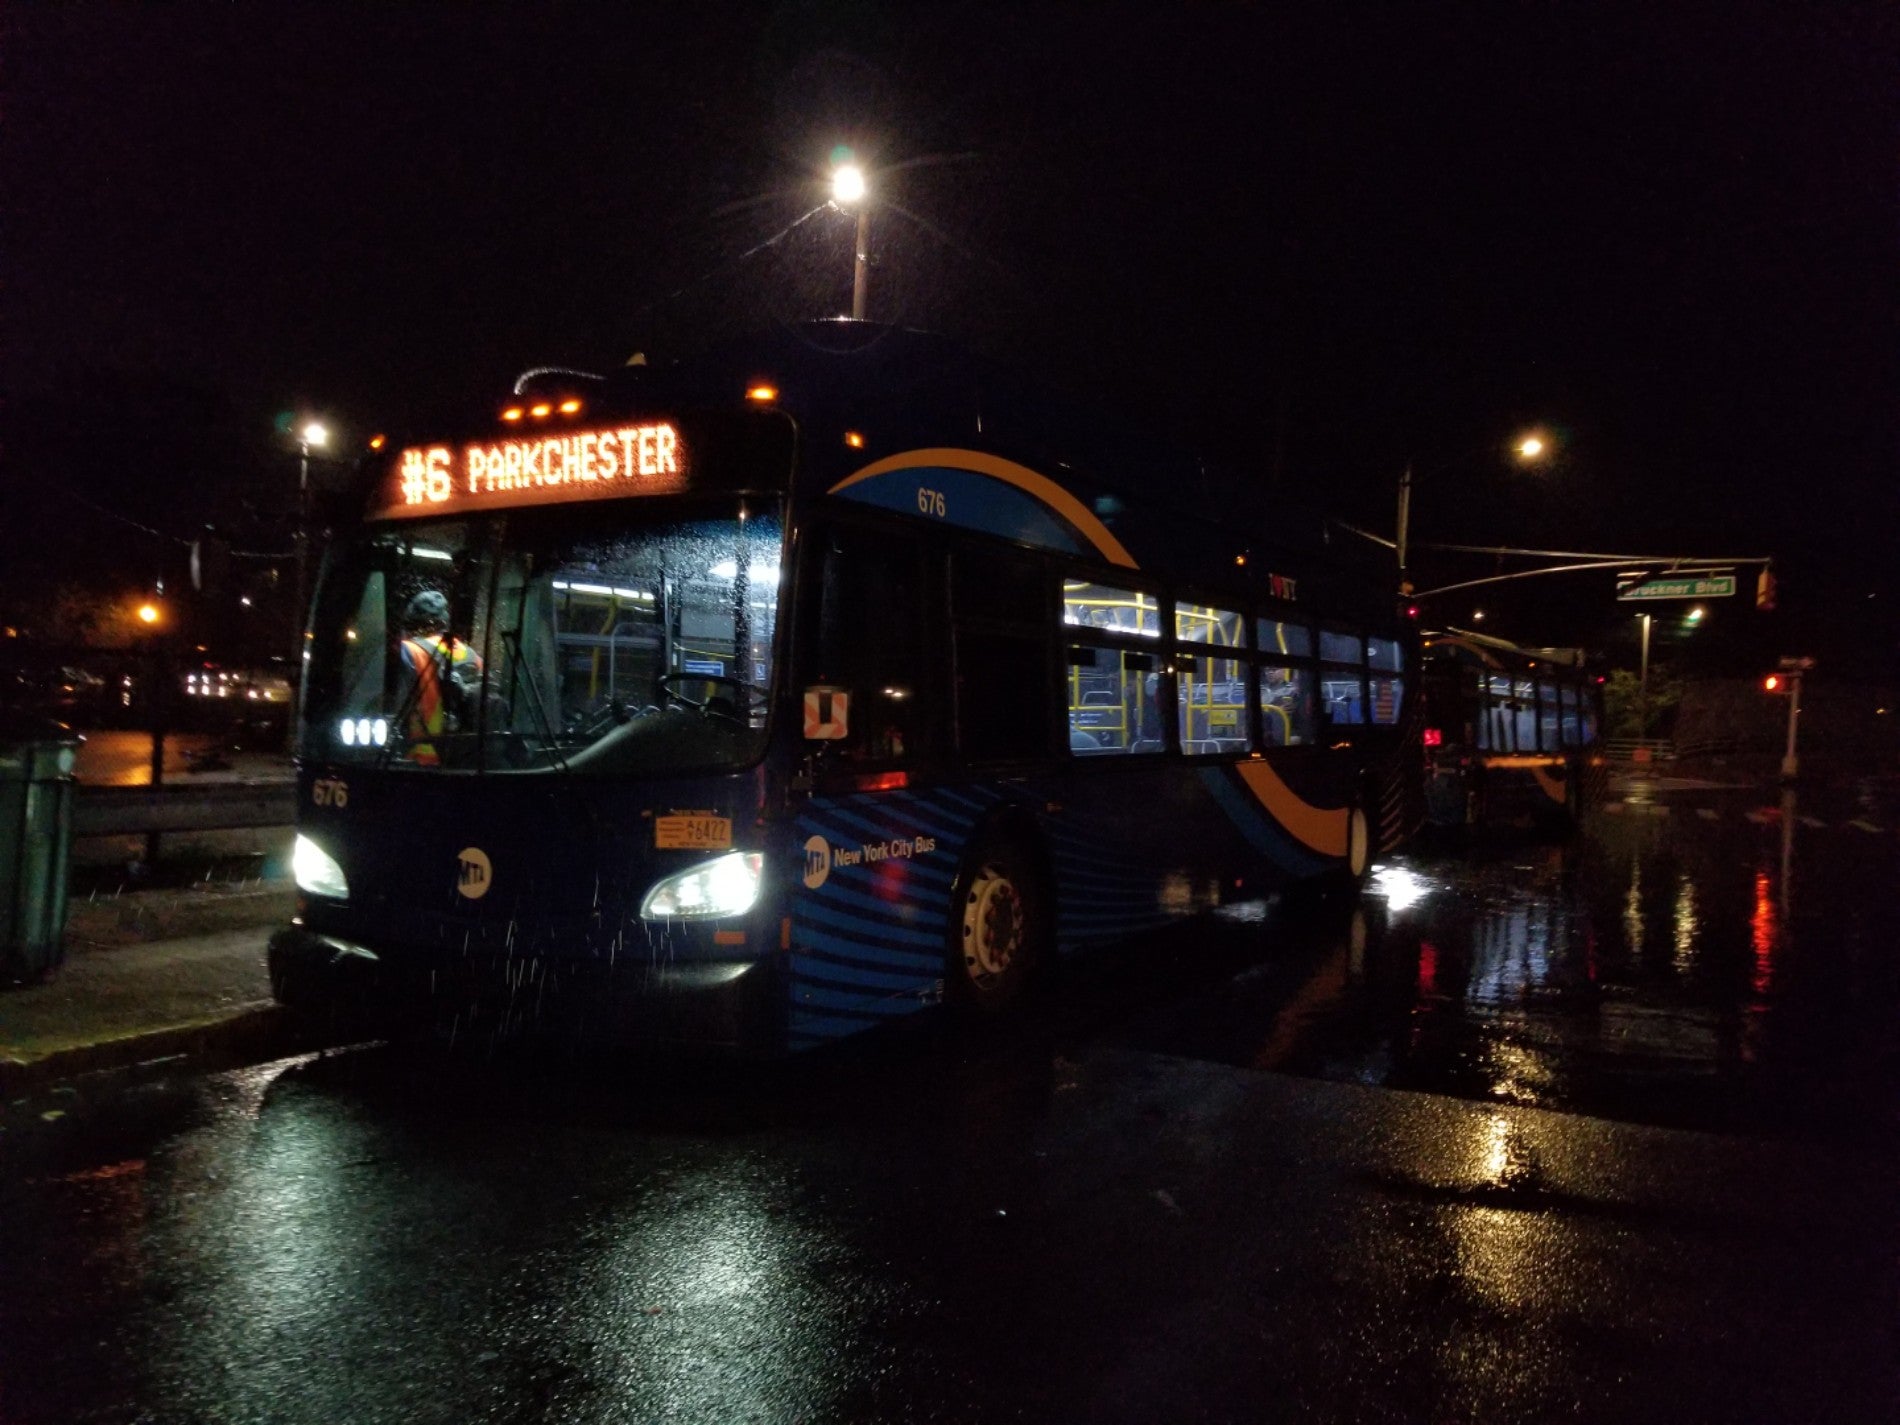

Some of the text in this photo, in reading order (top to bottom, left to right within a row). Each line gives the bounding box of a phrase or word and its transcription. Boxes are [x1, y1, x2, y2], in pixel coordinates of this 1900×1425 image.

[401, 423, 677, 505] #6 PARKCHESTER
[918, 487, 946, 517] 676
[1695, 580, 1729, 594] Blvd
[313, 778, 349, 808] 676
[834, 836, 936, 867] New York City Bus
